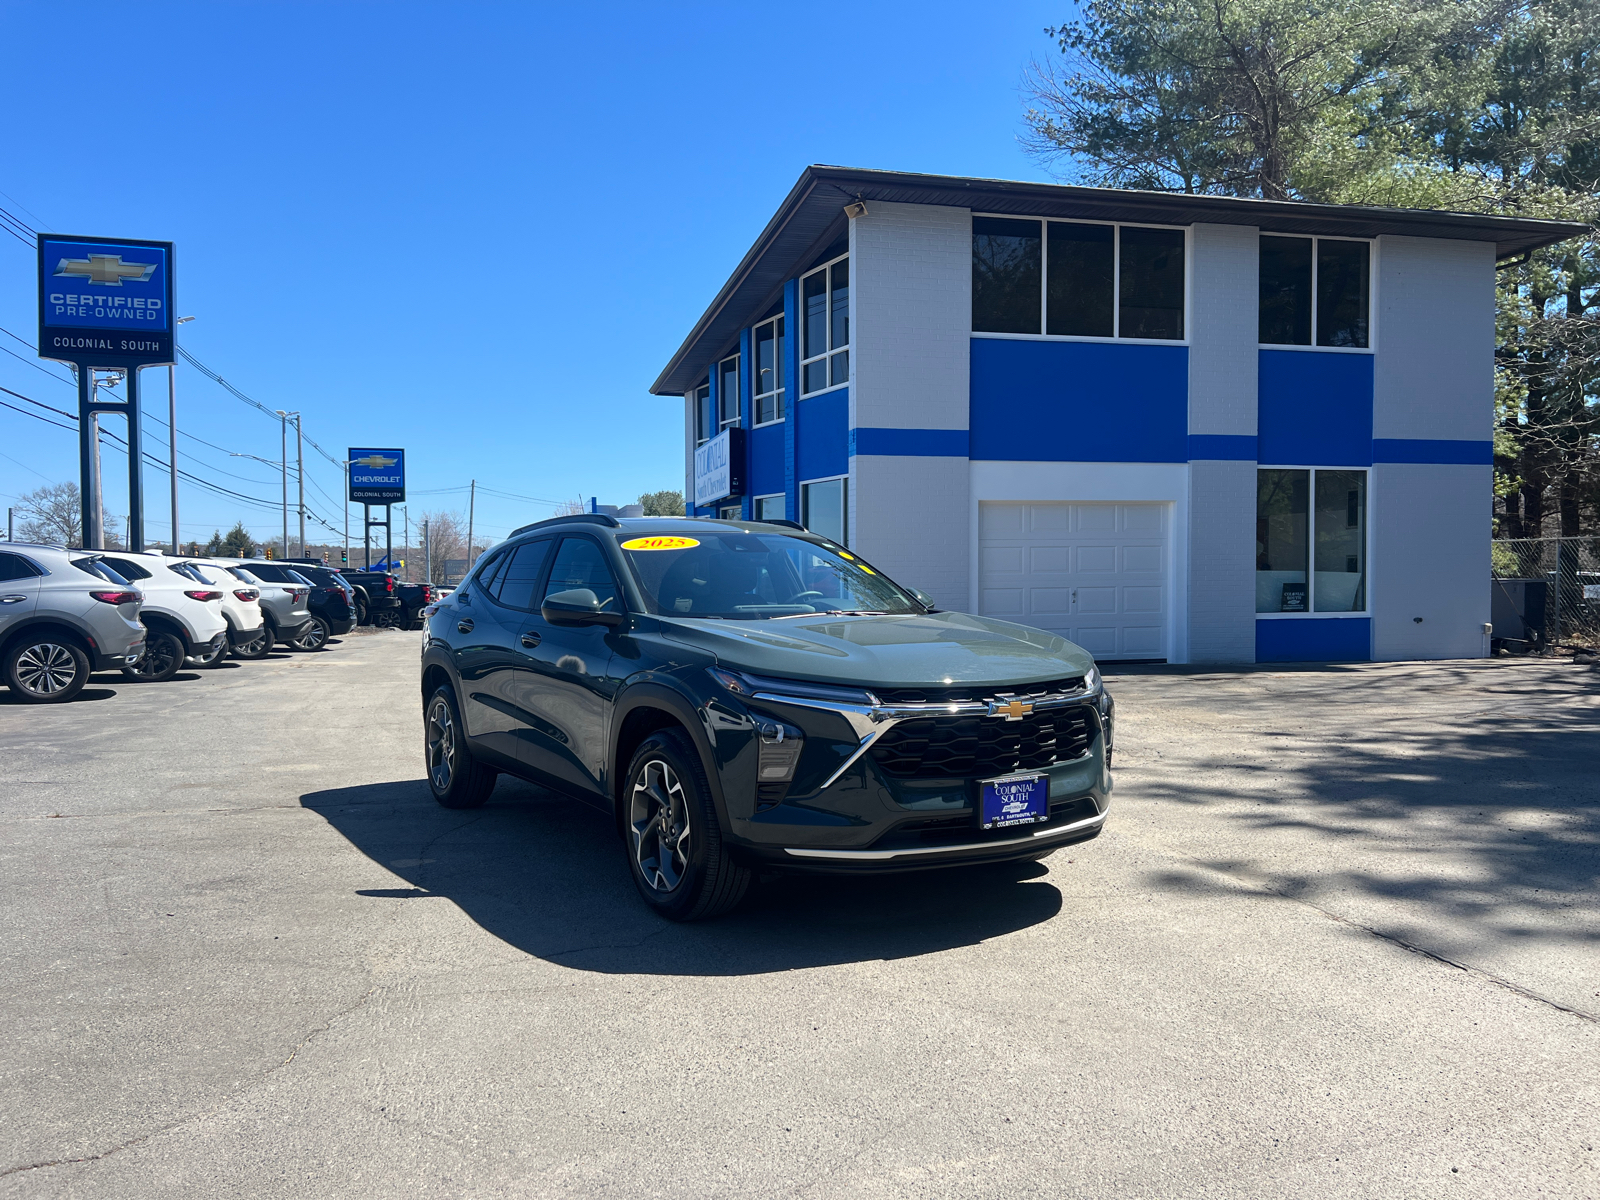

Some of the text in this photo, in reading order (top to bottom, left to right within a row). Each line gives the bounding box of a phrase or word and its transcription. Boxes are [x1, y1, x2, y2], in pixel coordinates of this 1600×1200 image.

[50, 293, 161, 309] CERTIFIED
[55, 305, 156, 320] PRE-OWNED
[53, 336, 159, 351] COLONIAL SOUTH
[638, 538, 687, 549] 2025
[995, 783, 1035, 796] COLONIAL
[1001, 792, 1029, 804] SOUTH
